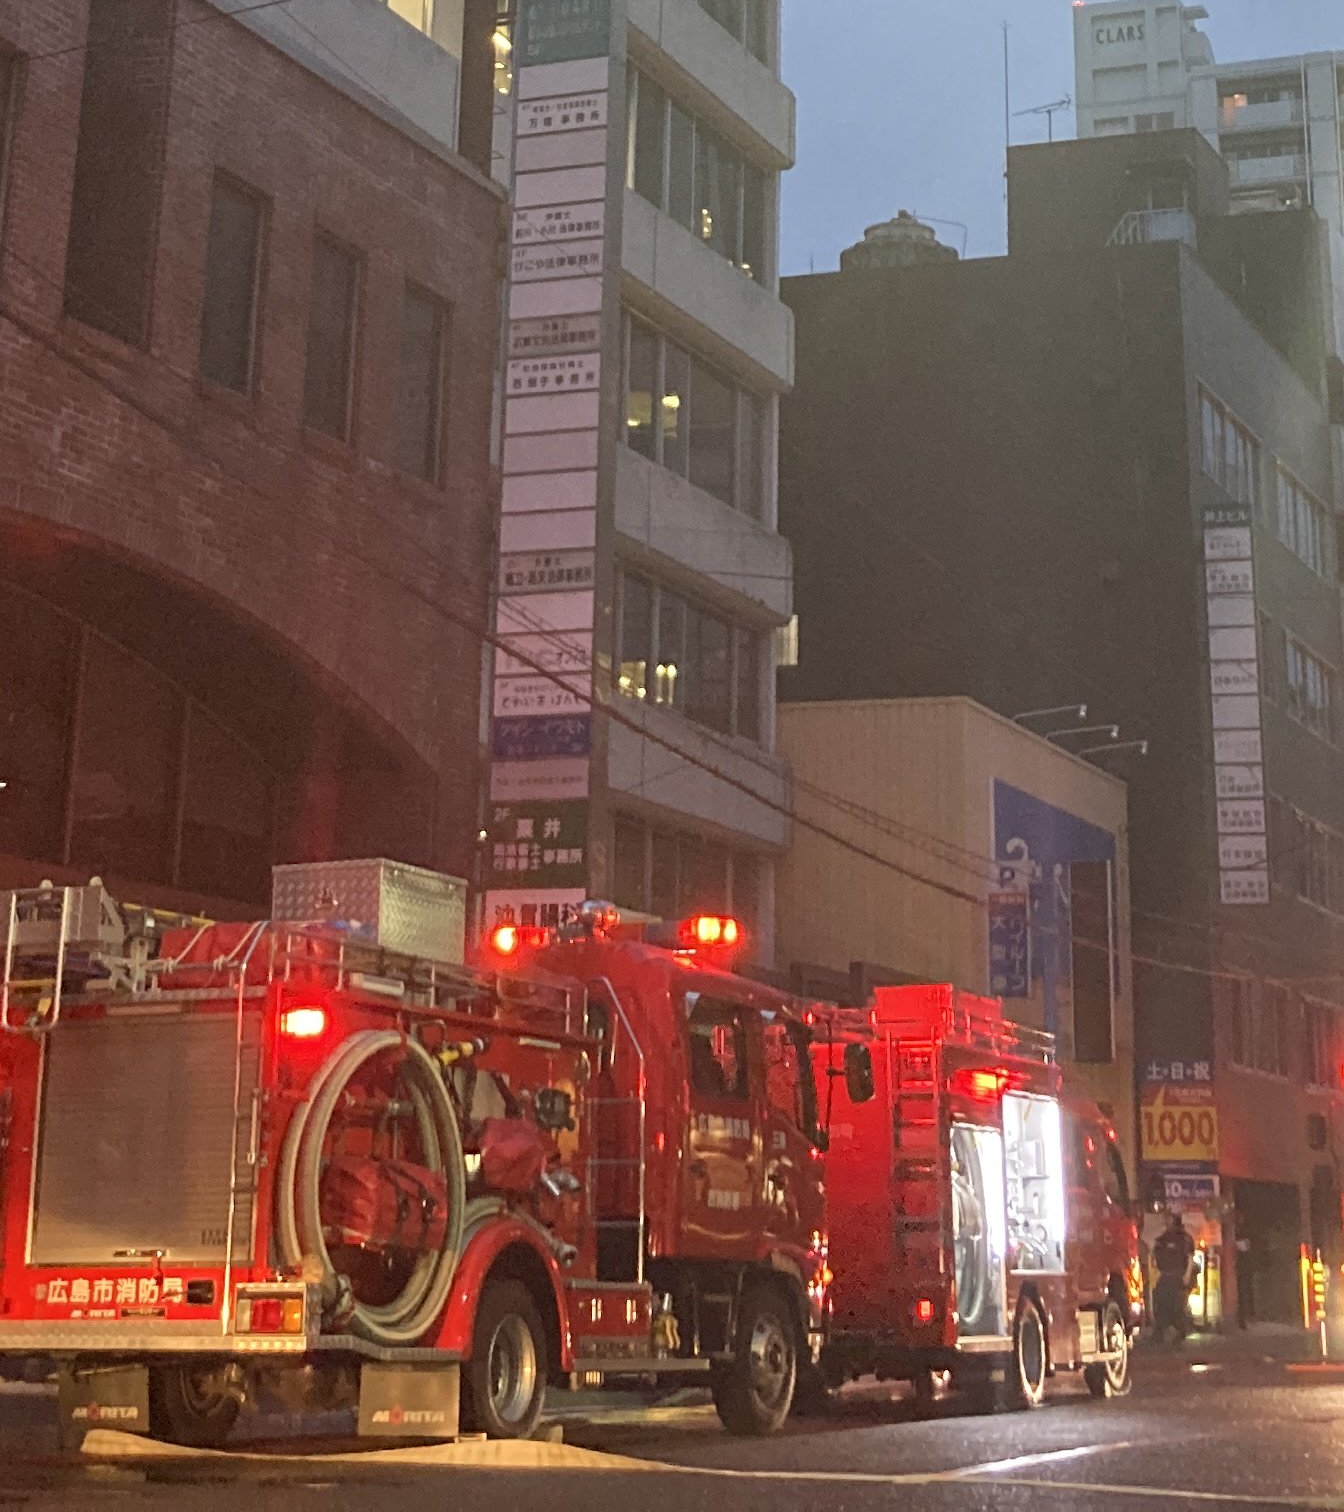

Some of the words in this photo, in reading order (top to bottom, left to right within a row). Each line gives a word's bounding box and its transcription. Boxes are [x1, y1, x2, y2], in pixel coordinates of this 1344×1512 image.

[1095, 24, 1145, 44] CLARS
[1143, 1110, 1215, 1149] 1,000
[46, 1277, 184, 1304] 広島市消防局
[70, 1400, 139, 1421] MORITA
[371, 1402, 445, 1423] MORITA
